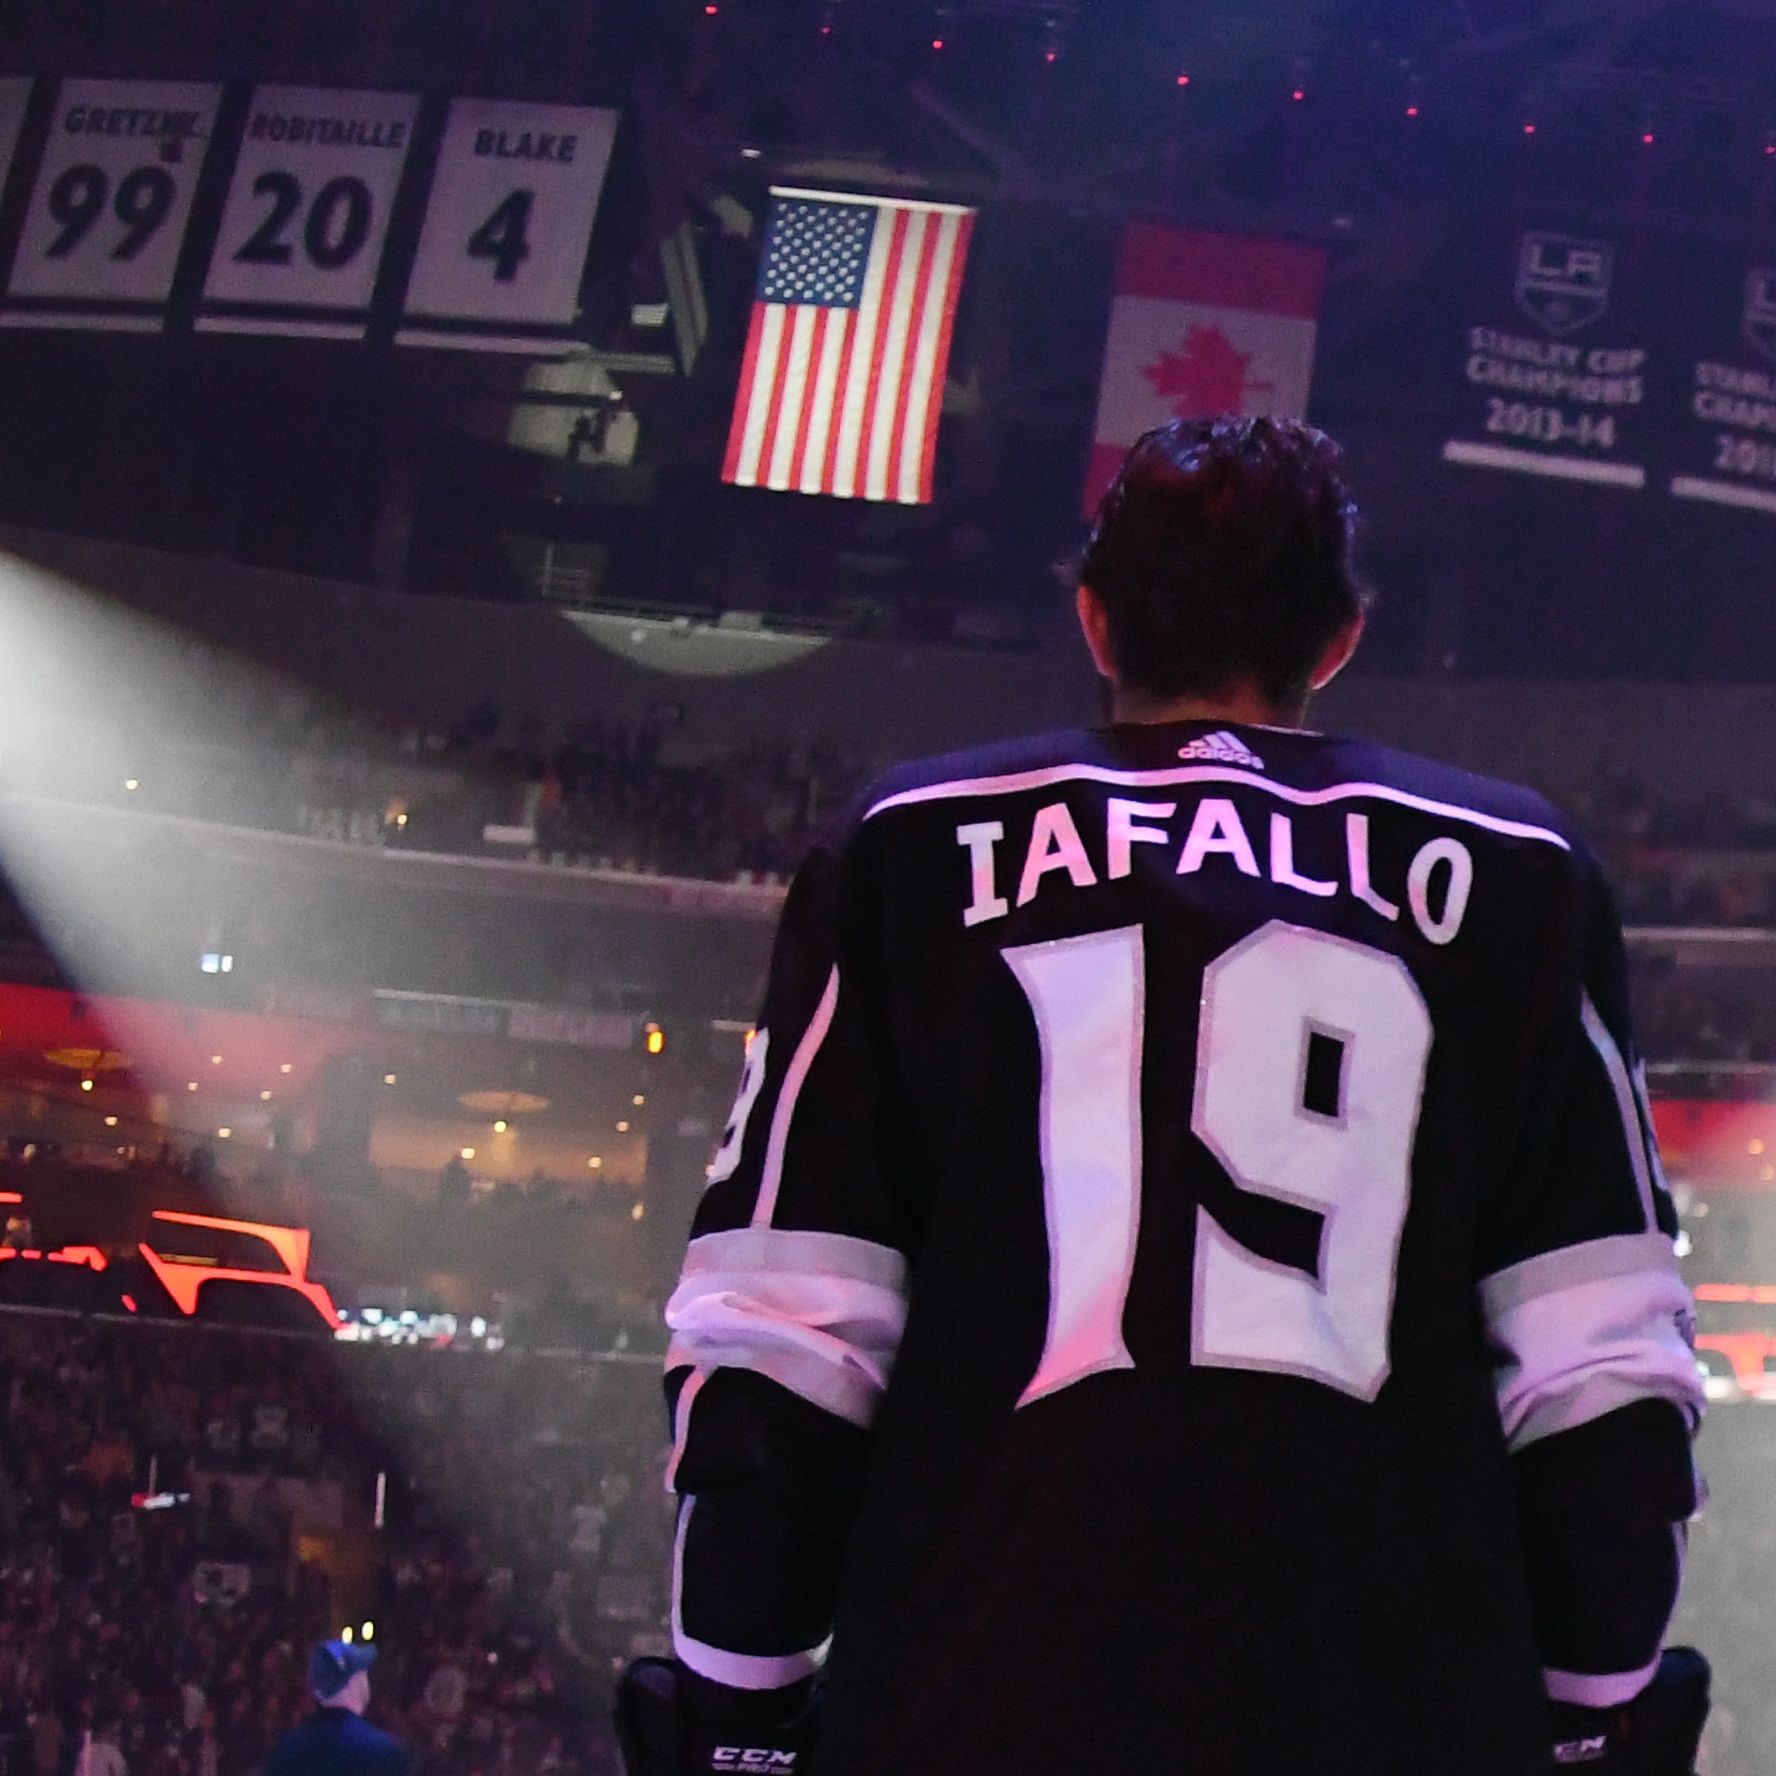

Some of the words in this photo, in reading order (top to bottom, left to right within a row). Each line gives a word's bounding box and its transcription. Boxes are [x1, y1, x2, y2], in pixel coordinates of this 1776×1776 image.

[250, 113, 408, 148] ROBITAILLE
[474, 128, 578, 163] BLAKE
[46, 164, 177, 260] 99
[233, 170, 373, 271] 20
[467, 188, 535, 283] 4
[1466, 355, 1643, 404] CHAMPIONS
[1177, 746, 1265, 770] adidas
[956, 798, 1473, 947] IAFALLO
[1001, 920, 1434, 1408] 19
[713, 1745, 797, 1765] CCM
